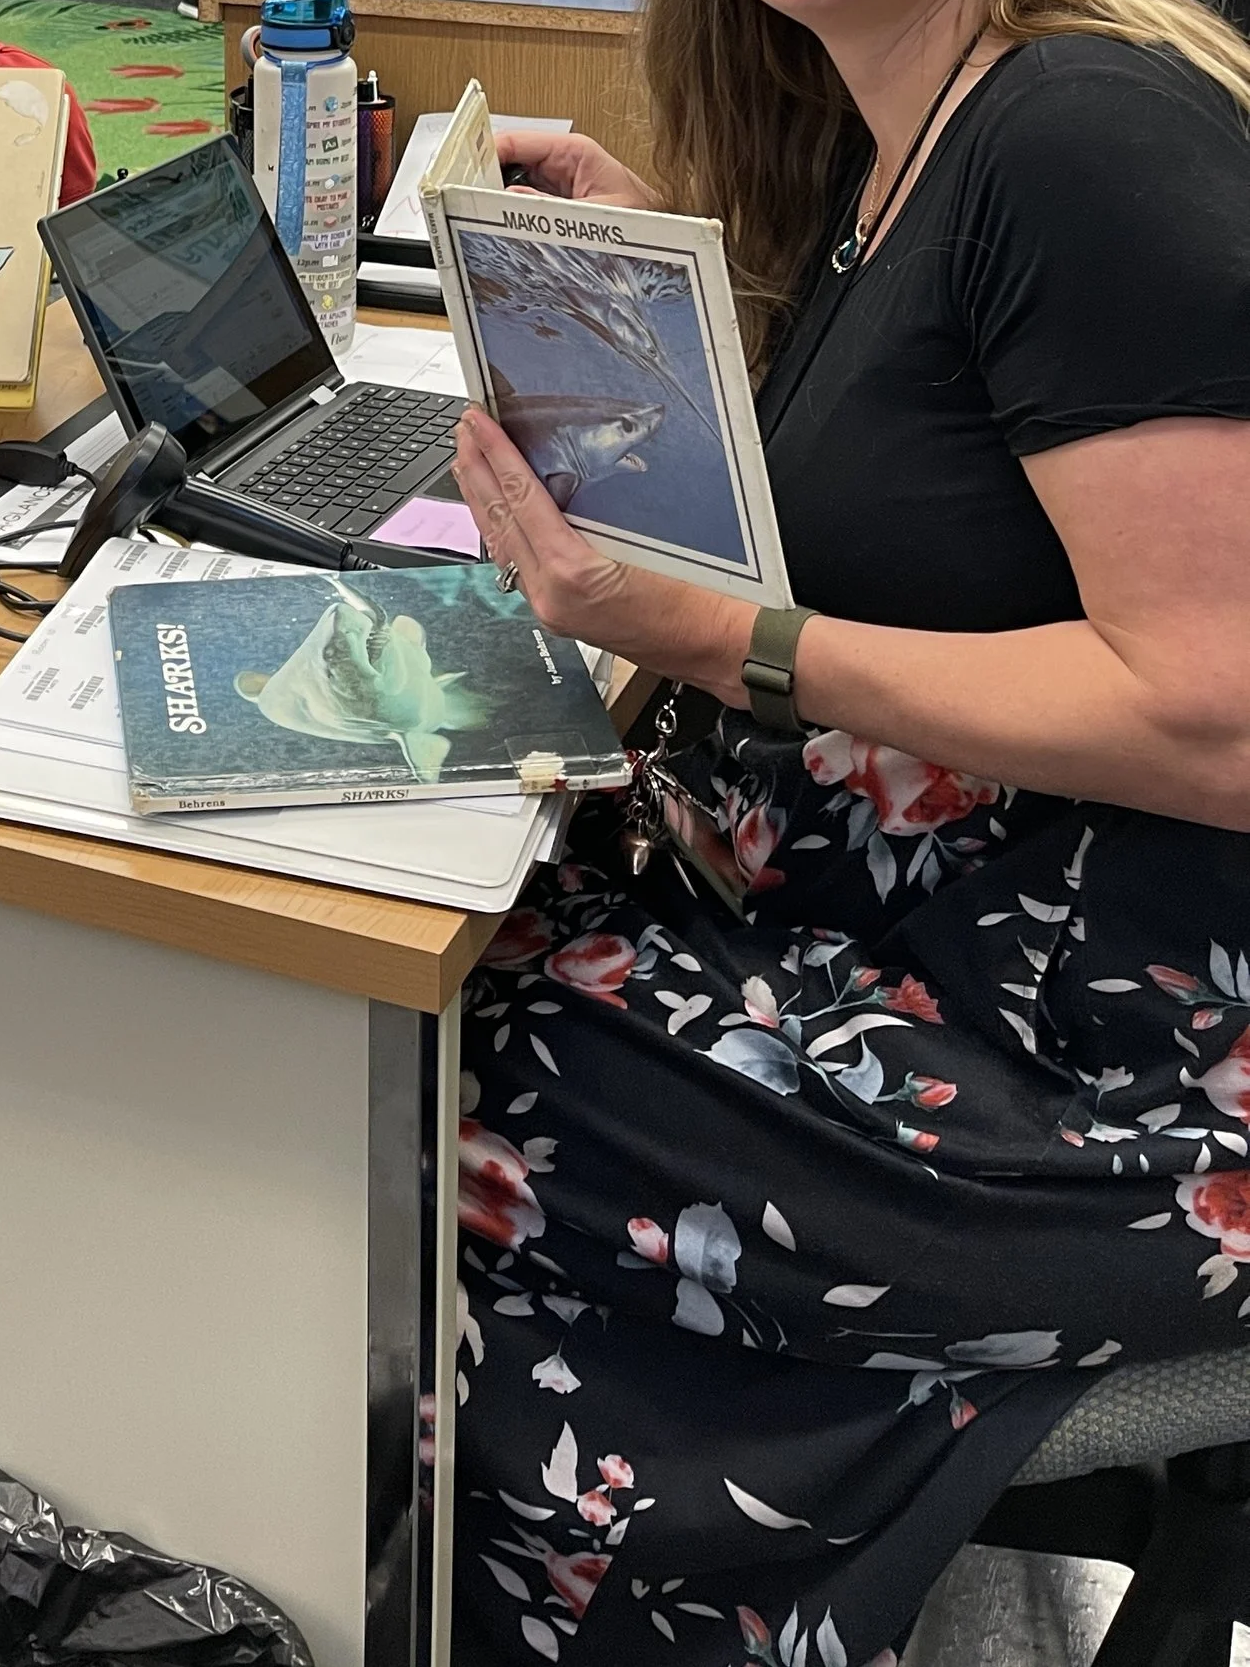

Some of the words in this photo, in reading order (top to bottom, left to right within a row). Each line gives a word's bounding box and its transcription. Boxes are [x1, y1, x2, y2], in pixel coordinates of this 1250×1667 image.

[428, 213, 438, 234] MAKO
[502, 210, 551, 234] MAKO
[554, 221, 624, 245] SHARKS
[156, 623, 207, 734] SHARKS!
[551, 675, 563, 685] by
[178, 799, 226, 810] Behrens
[341, 787, 410, 802] SHARKS!
